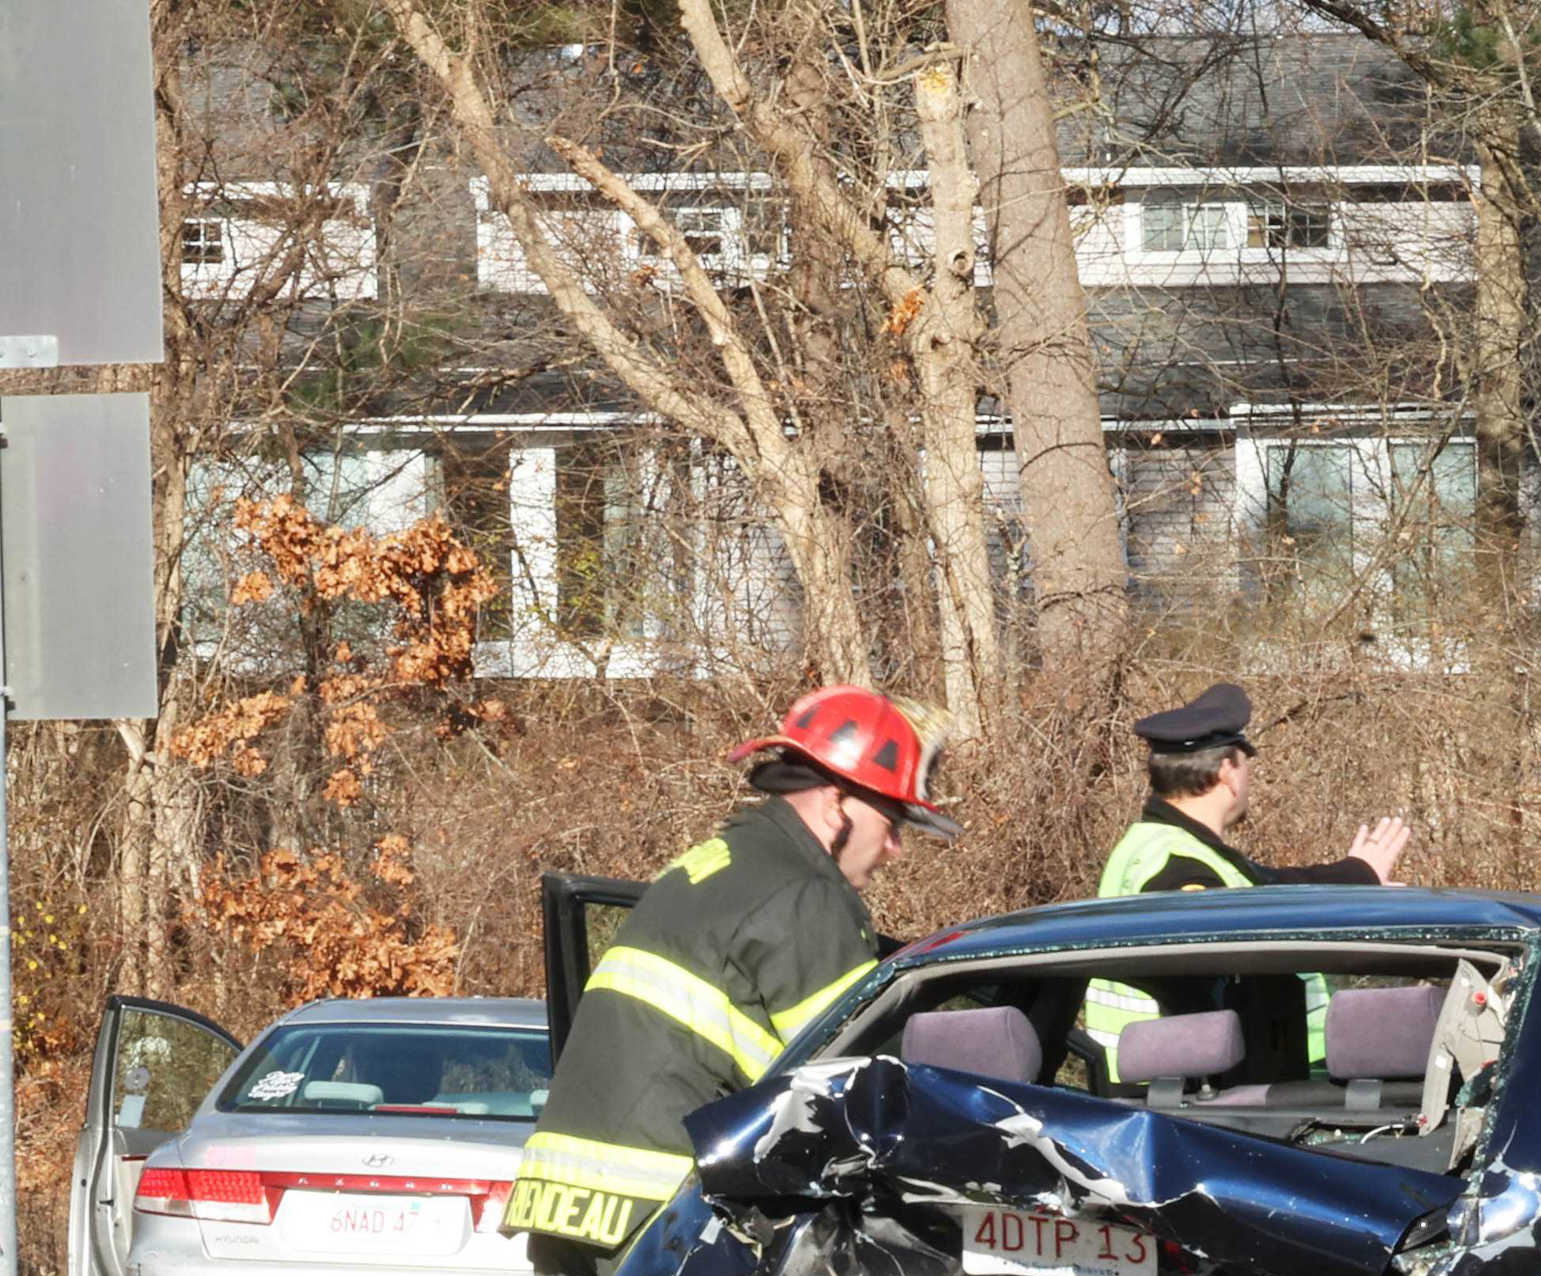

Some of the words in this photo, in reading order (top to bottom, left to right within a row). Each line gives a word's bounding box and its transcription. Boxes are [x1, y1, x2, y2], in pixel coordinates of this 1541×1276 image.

[331, 1209, 385, 1234] 6NAD
[975, 1211, 1079, 1259] 4DTP
[1097, 1224, 1147, 1264] 13
